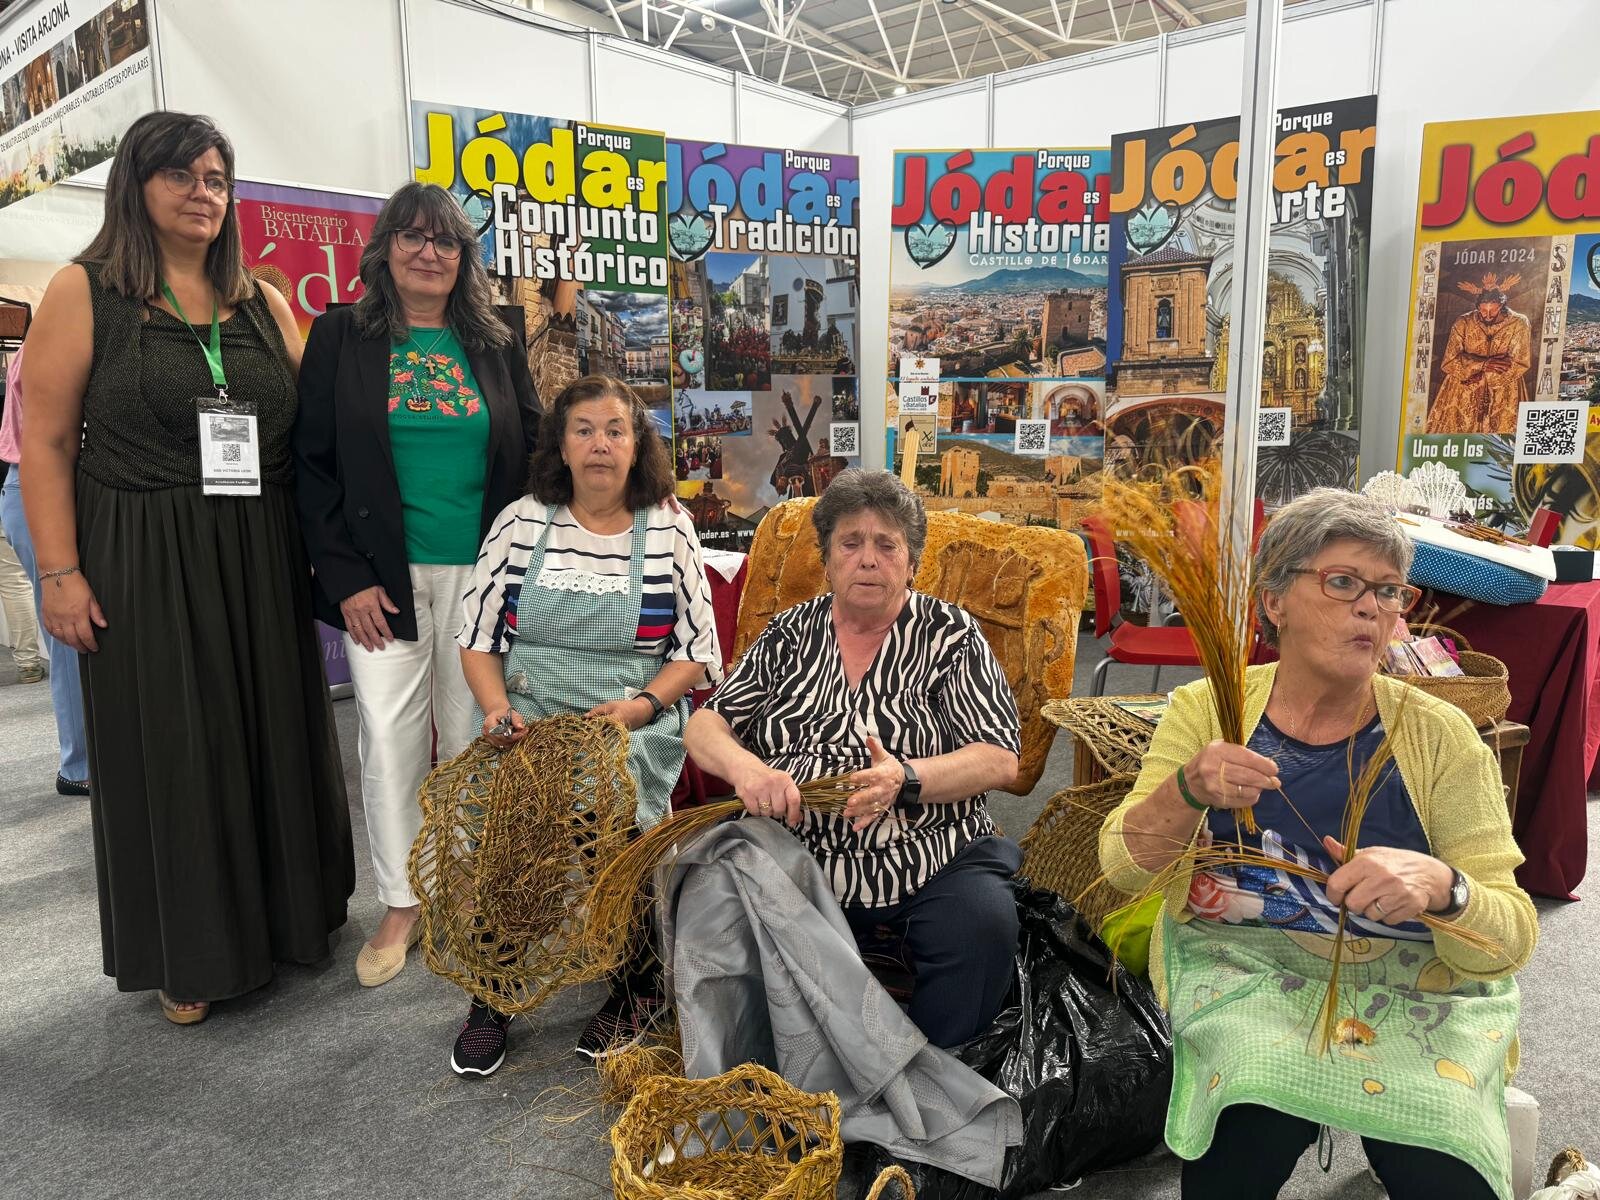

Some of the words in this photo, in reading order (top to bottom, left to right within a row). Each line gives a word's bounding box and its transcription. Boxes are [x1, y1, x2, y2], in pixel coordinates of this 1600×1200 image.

[14, 24, 38, 56] VISITA
[38, 0, 70, 40] ARJONA
[82, 82, 105, 105] NOTABLES
[104, 73, 122, 92] FIESTAS
[121, 56, 149, 82] POPULARES
[577, 125, 631, 152] Porque
[415, 112, 668, 213] Jódar
[785, 150, 831, 173] Porque
[1037, 150, 1090, 172] Porque
[1325, 150, 1346, 166] es
[627, 176, 645, 191] es
[1083, 191, 1100, 204] es
[493, 183, 659, 247] Conjunto
[826, 195, 841, 208] es
[1270, 181, 1347, 223] rte
[260, 204, 348, 228] Bicentenario
[708, 204, 857, 255] Tradición
[263, 219, 365, 247] BATALLA
[969, 211, 1110, 254] Historia
[496, 229, 668, 287] Histórico
[1454, 249, 1495, 265] JÓDAR
[1500, 248, 1536, 263] 2024
[1413, 249, 1437, 394] SEMANA
[1537, 243, 1569, 395] SANTA
[1412, 438, 1438, 458] Uno
[1442, 438, 1458, 458] de
[1463, 438, 1484, 458] los
